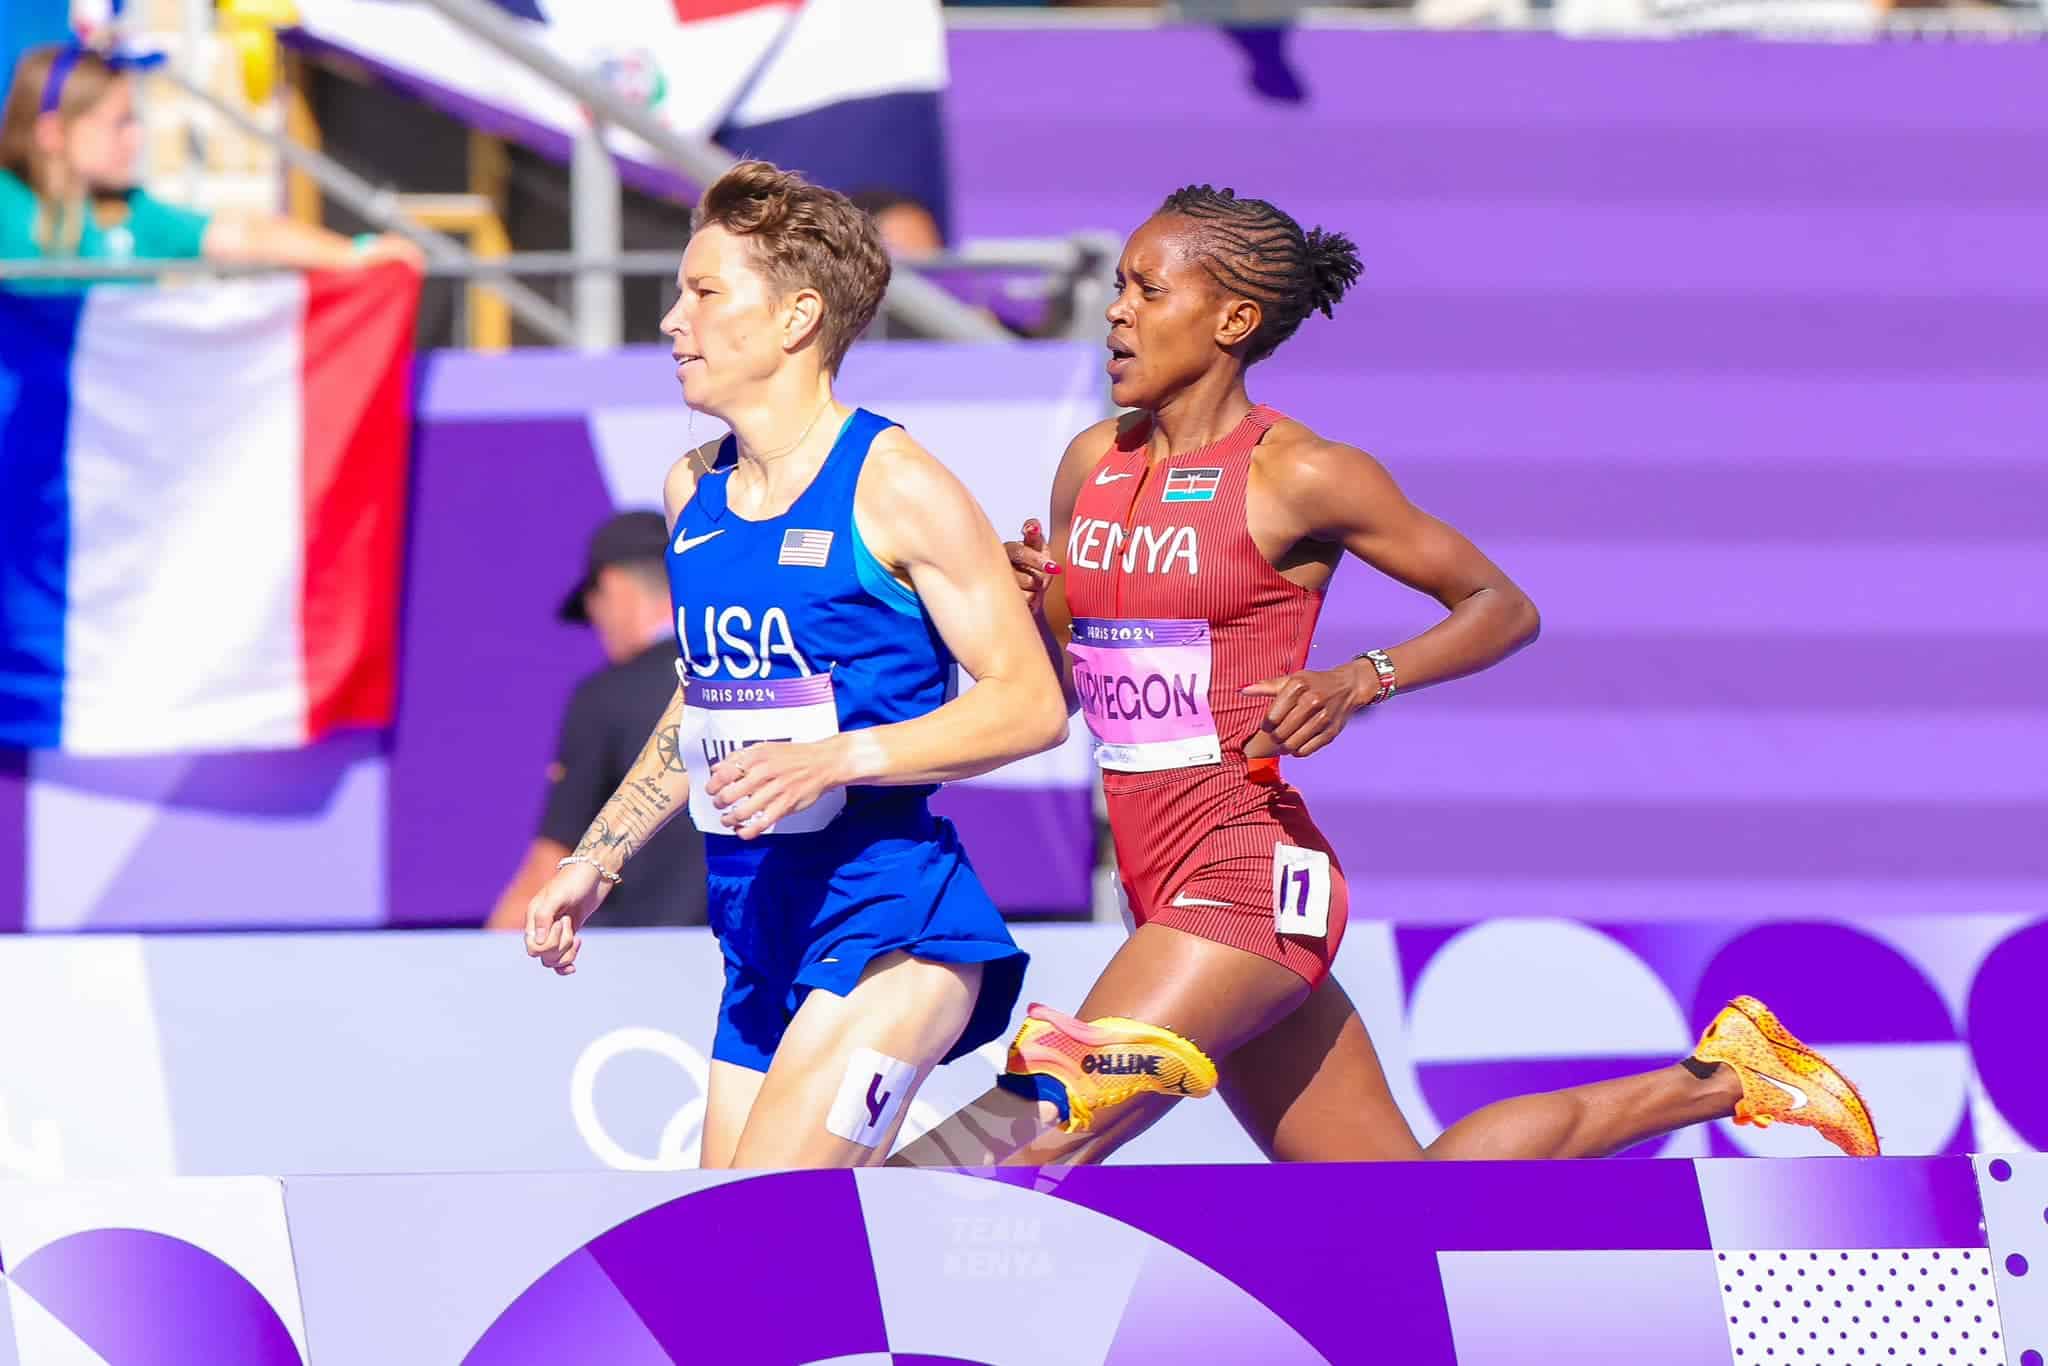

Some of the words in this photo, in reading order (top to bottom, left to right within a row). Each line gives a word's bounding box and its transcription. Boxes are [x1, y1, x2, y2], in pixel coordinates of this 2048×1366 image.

[1067, 515, 1198, 575] KENYA
[677, 605, 811, 679] USA
[1111, 626, 1154, 641] 2024
[736, 687, 776, 703] 2024
[1081, 1054, 1164, 1075] NITRO
[866, 1072, 891, 1128] 4
